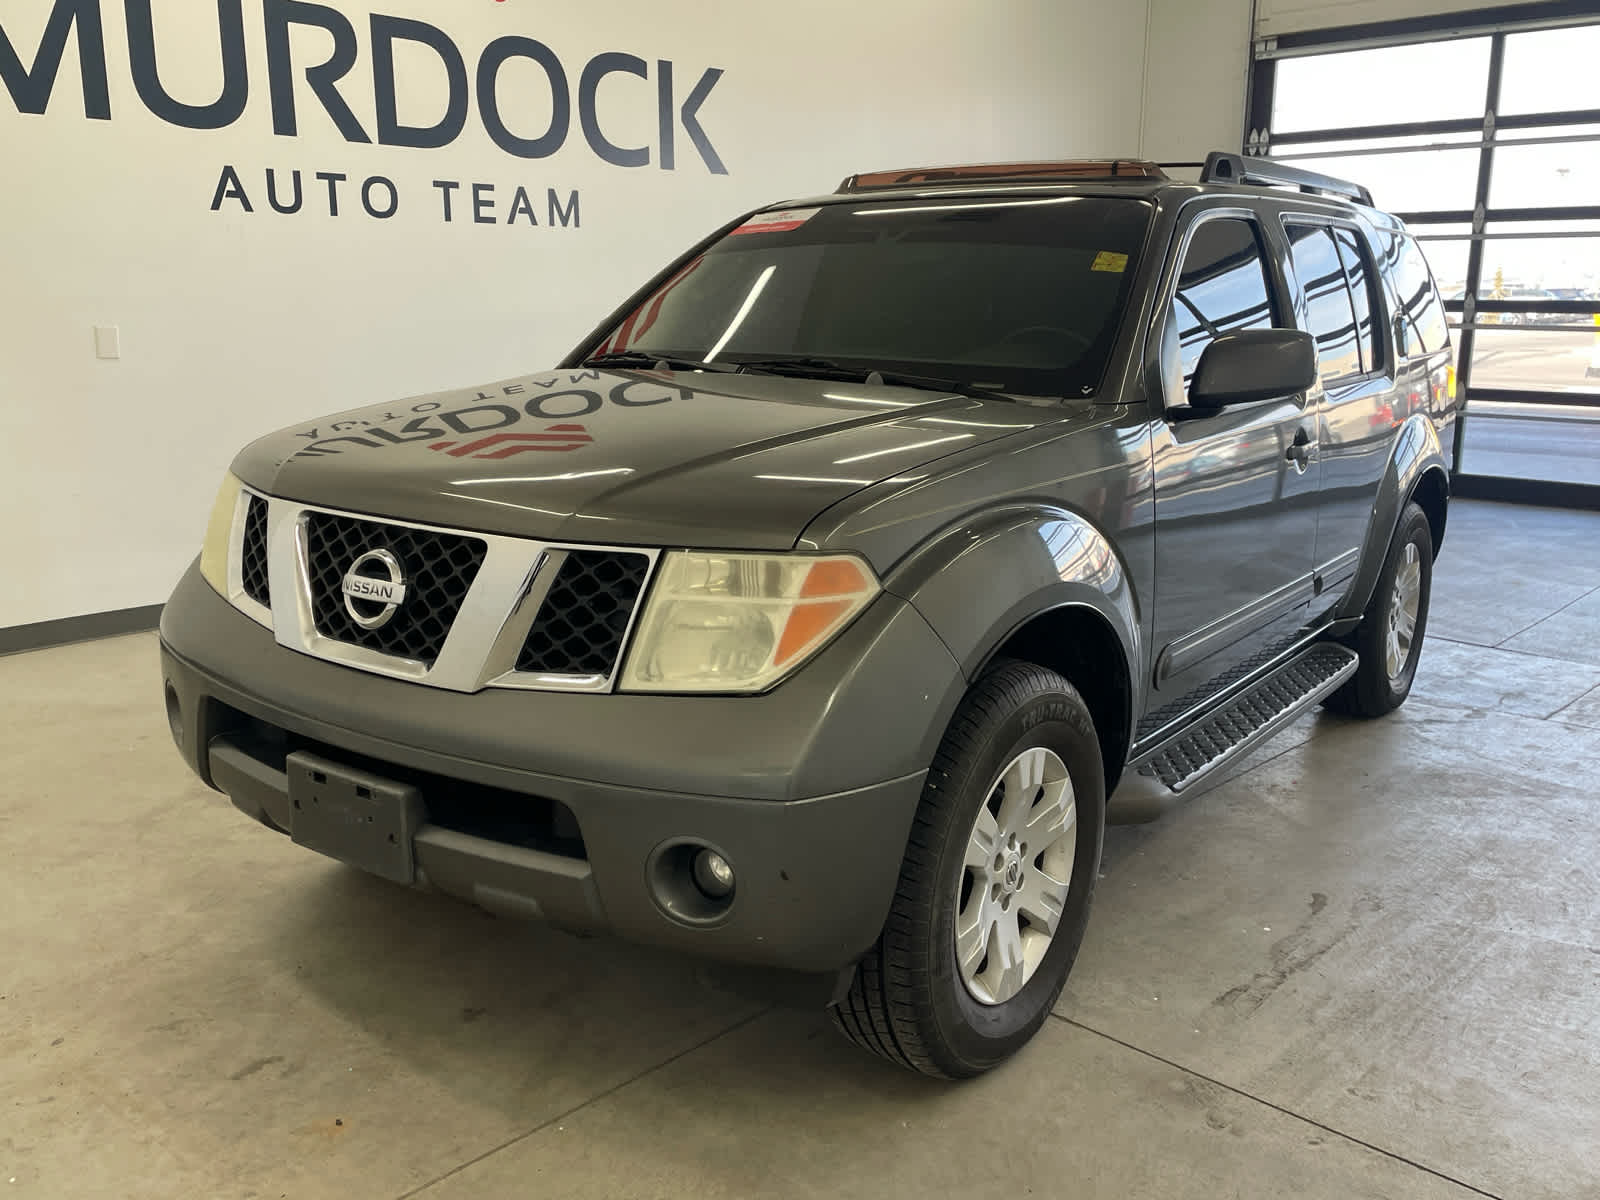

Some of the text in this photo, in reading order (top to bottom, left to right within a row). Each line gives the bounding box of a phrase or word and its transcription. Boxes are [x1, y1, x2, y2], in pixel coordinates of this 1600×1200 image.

[211, 166, 580, 228] AUTO TEAM
[344, 580, 393, 599] NISSAN
